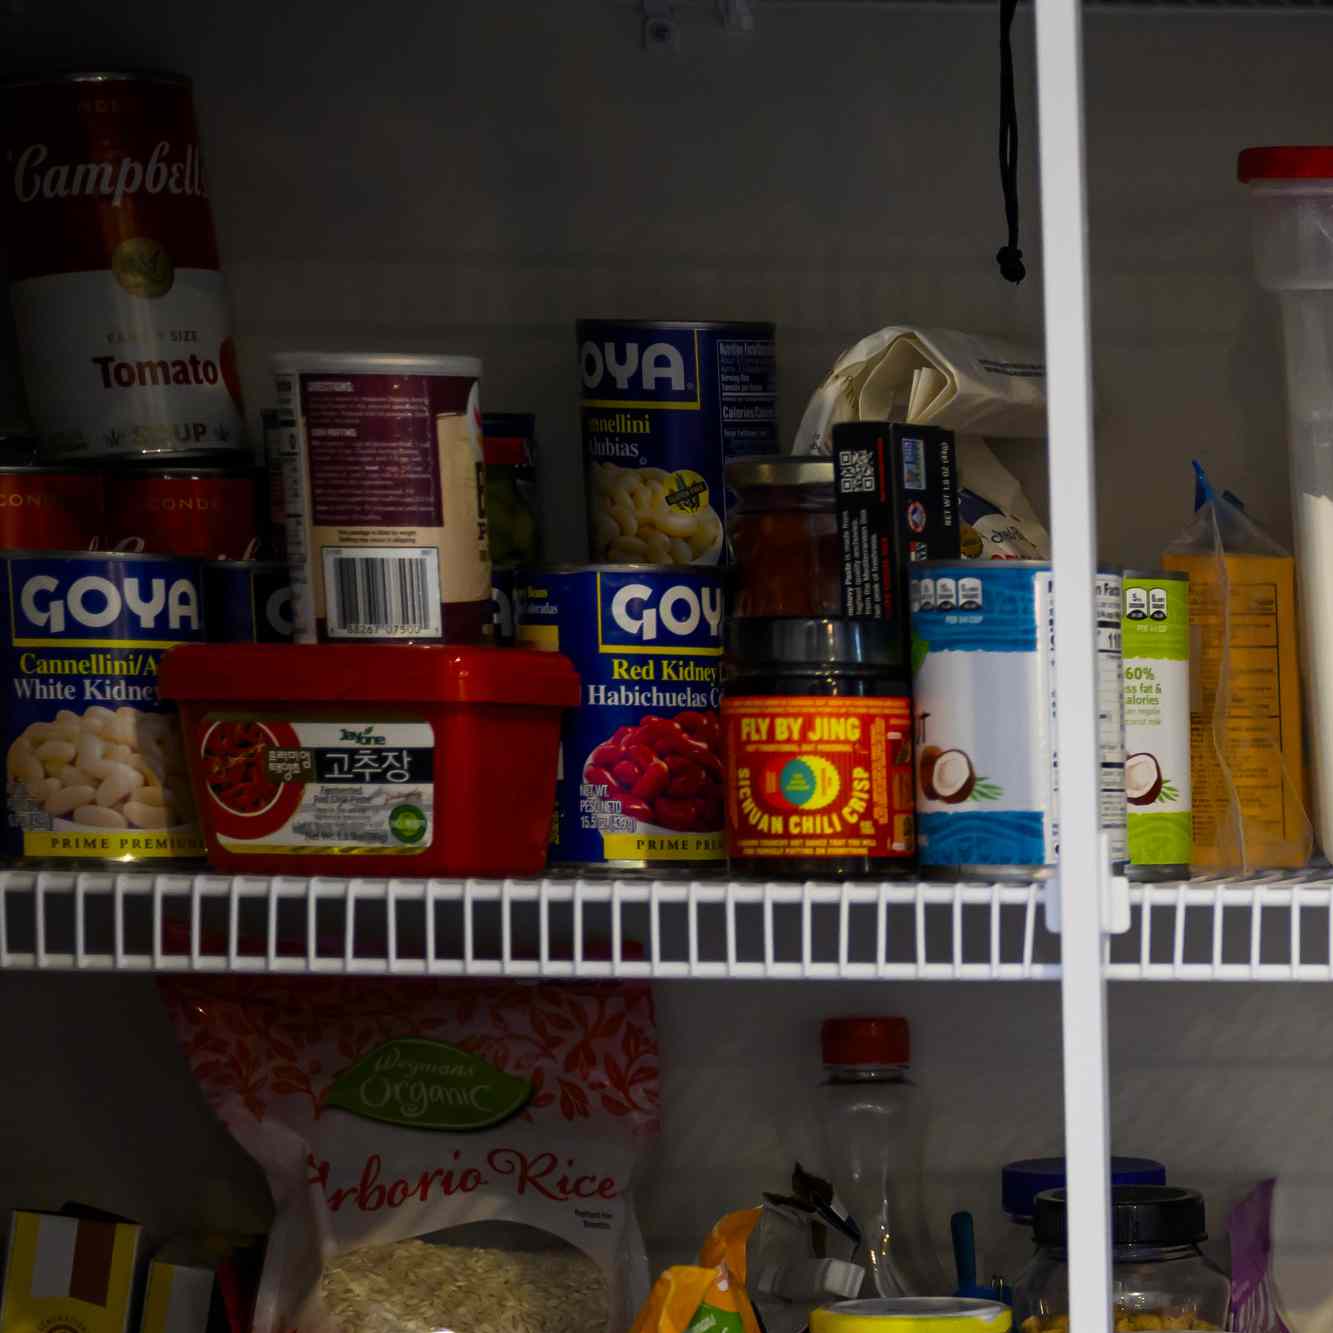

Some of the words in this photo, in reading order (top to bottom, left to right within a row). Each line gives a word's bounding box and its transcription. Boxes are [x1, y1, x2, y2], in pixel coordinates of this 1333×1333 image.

[92, 354, 218, 388] Tomato
[581, 340, 686, 391] OYA
[20, 575, 200, 633] GOYA
[612, 657, 655, 682] Red
[661, 659, 719, 687] Kidney
[1125, 666, 1155, 681] 60%
[13, 677, 77, 701] White
[587, 683, 708, 708] Habichuelas
[1139, 682, 1155, 695] fat
[740, 716, 772, 742] FLY
[774, 716, 804, 742] BY
[807, 716, 862, 742] JING
[321, 749, 415, 783] 고추장
[737, 765, 786, 836] SICHUAN
[787, 813, 843, 836] CHILI
[50, 837, 110, 851] PRIME
[636, 839, 688, 852] PRIME
[359, 1077, 497, 1117] Organic
[488, 1148, 618, 1201] Rice
